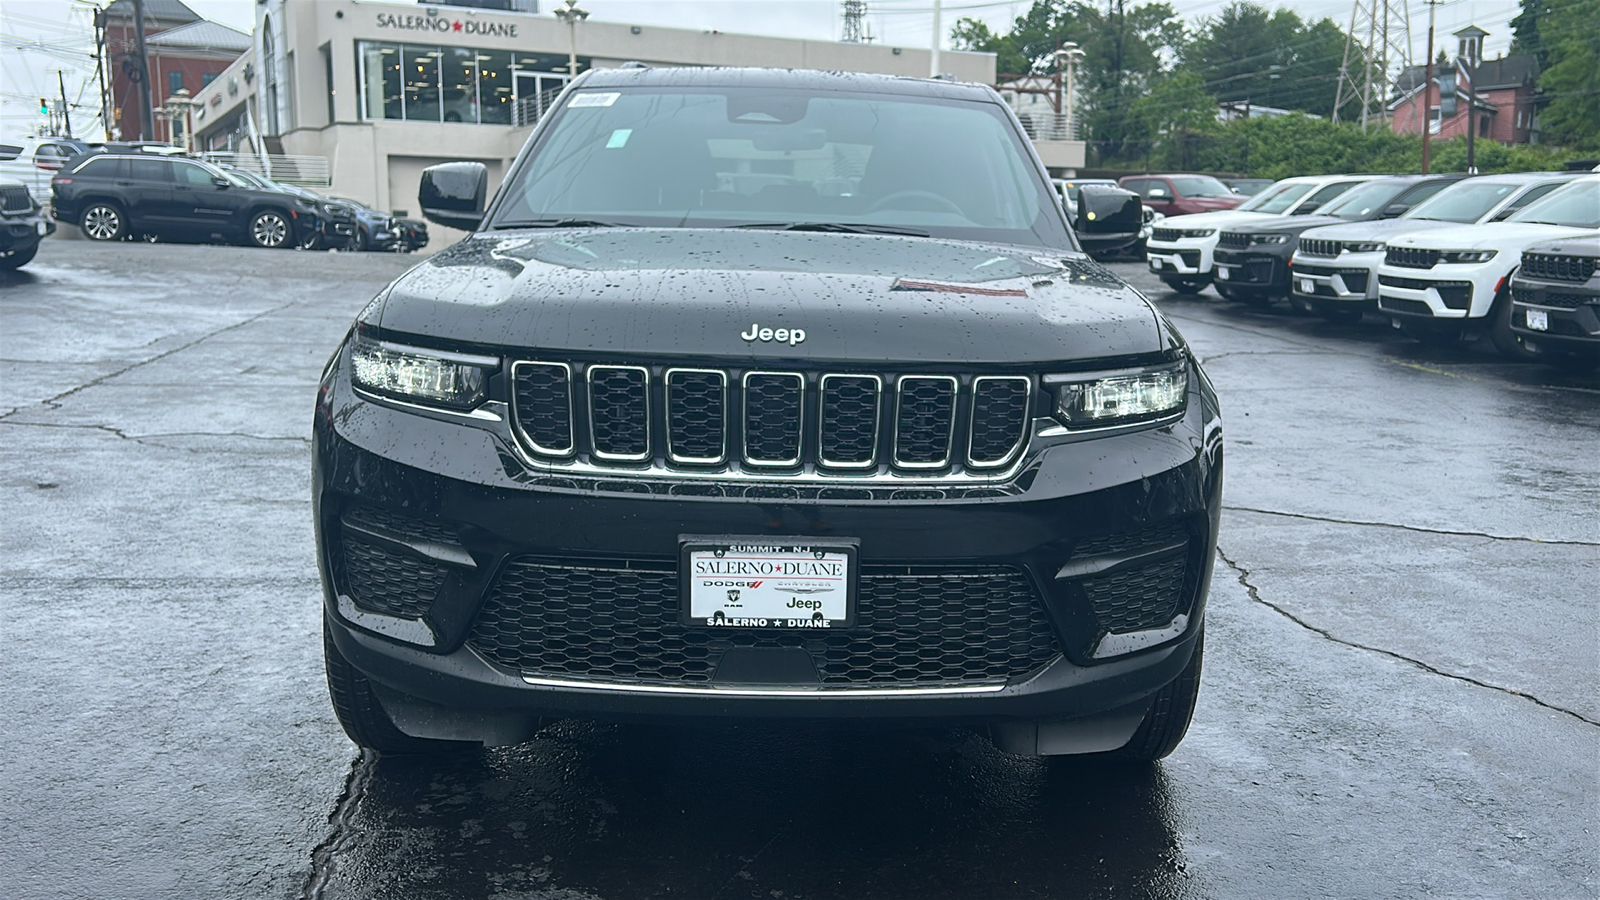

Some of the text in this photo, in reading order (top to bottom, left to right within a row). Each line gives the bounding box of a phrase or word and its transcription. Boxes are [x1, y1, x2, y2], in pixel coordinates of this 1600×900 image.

[376, 12, 518, 38] SALERNO DUANE
[741, 323, 806, 346] Jeep
[696, 562, 842, 576] SALERNO DUANE
[786, 597, 822, 611] Jeep
[706, 618, 831, 628] SALERNO DUANE
